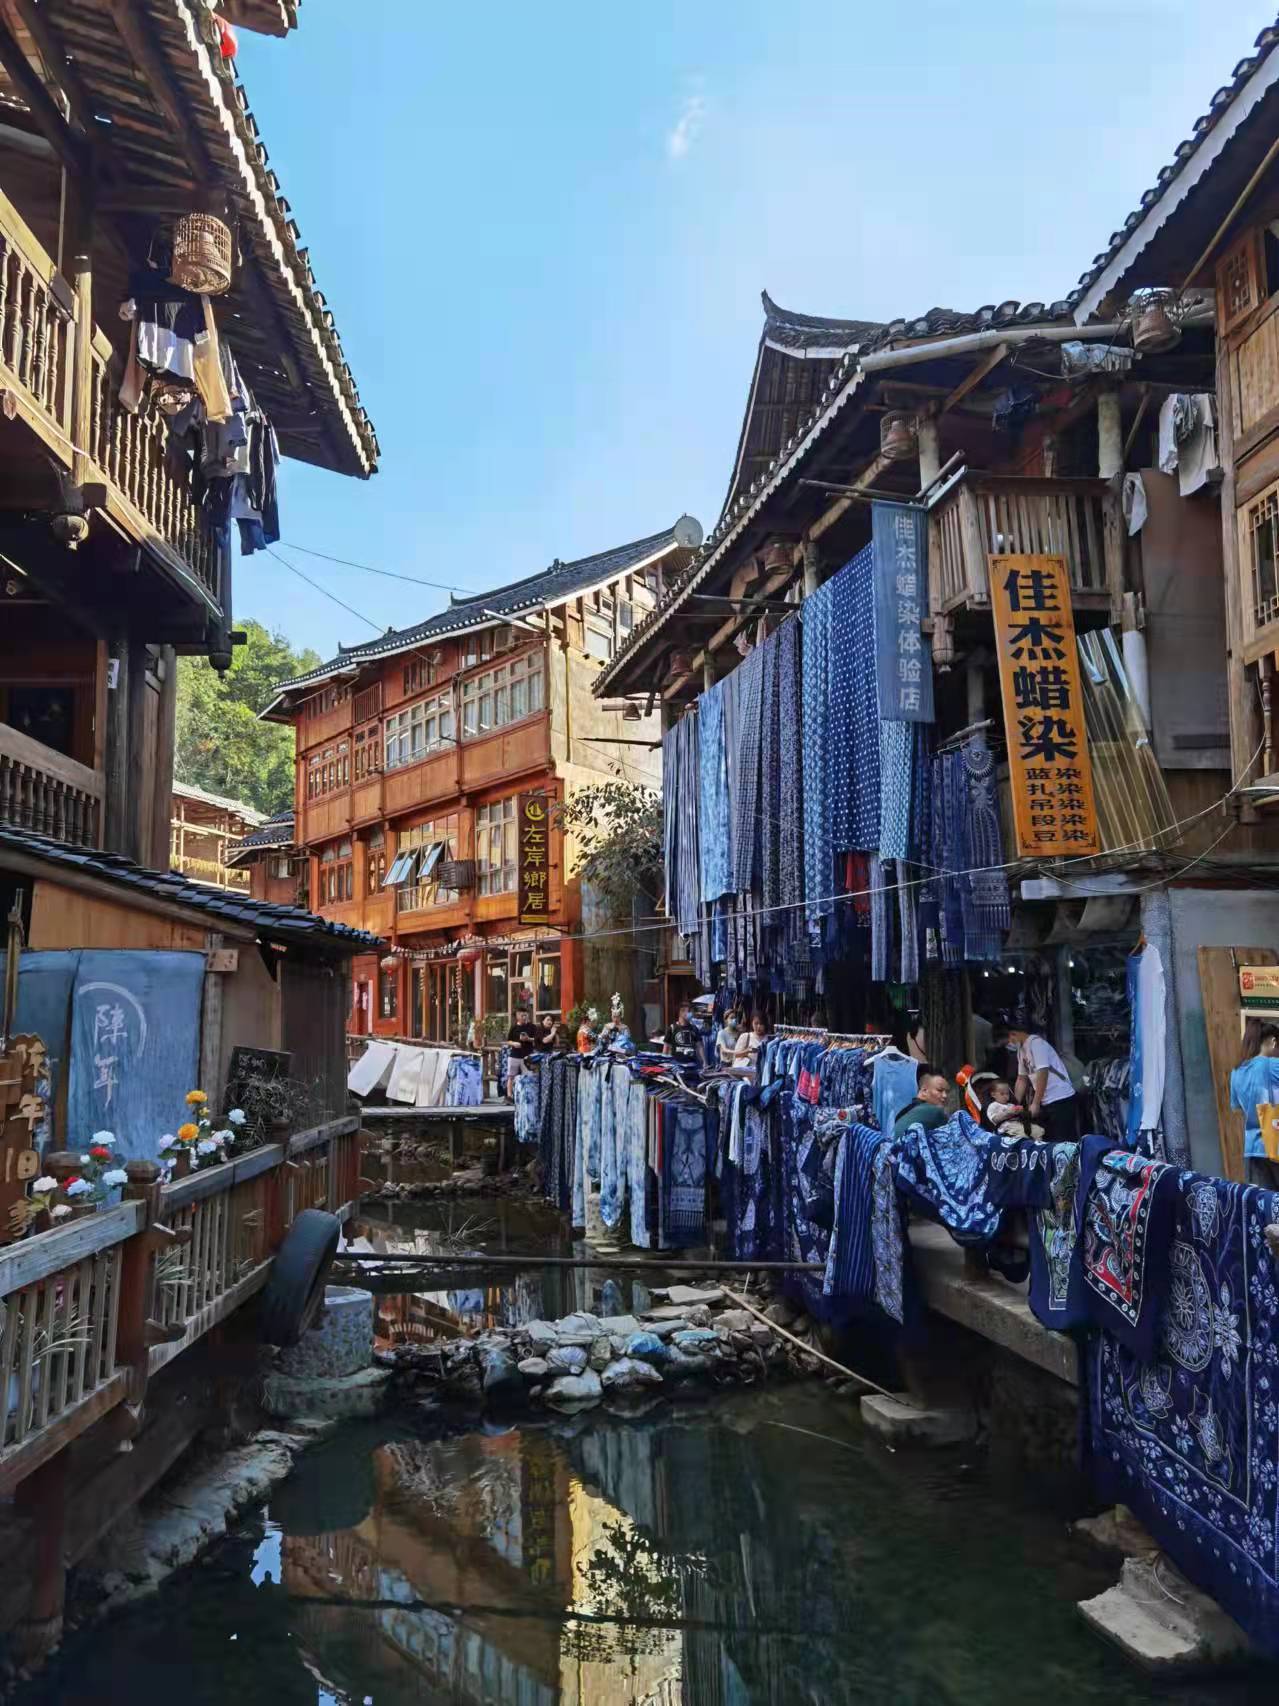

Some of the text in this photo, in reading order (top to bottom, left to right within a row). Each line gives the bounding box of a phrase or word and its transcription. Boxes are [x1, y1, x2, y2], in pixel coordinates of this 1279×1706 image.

[1003, 569, 1079, 762] 佳杰蜡染
[1024, 767, 1082, 780] 蓝染
[1026, 783, 1084, 797] 扎染
[1030, 799, 1088, 811] 吊染
[1031, 814, 1088, 826] 段染
[1032, 829, 1089, 842] 豆染
[523, 824, 546, 911] 左岸鄉居
